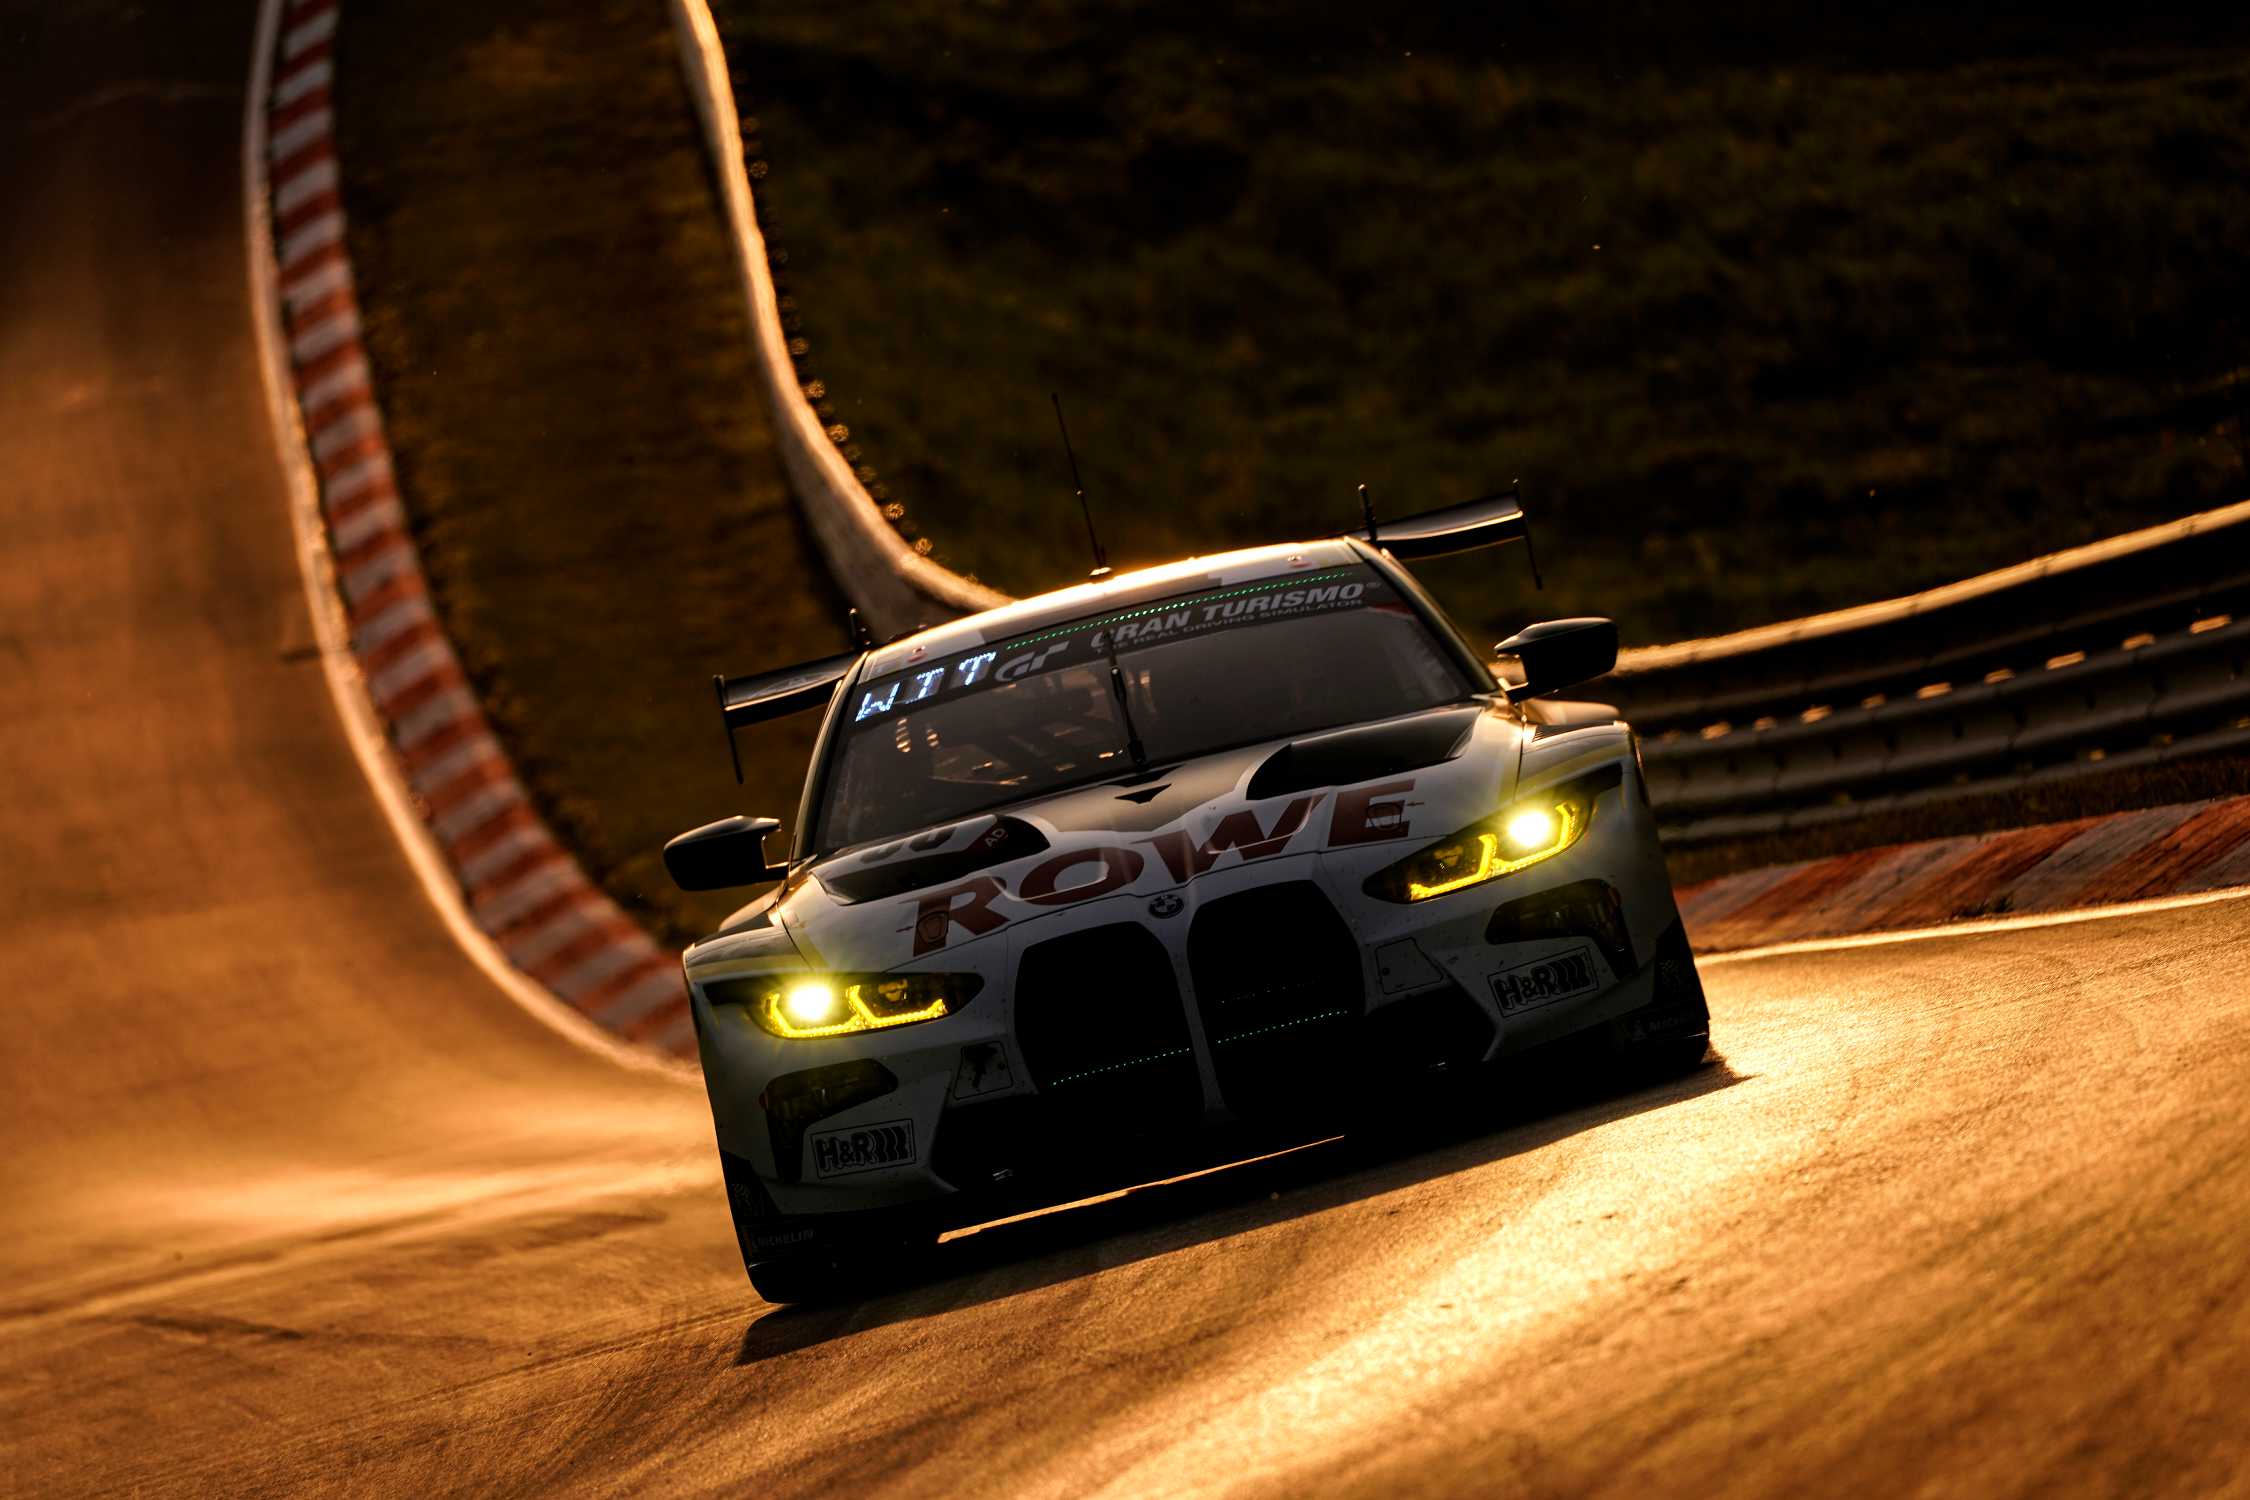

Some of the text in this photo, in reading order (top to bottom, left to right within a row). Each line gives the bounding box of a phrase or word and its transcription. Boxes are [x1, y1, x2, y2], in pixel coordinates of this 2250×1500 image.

[1090, 582, 1366, 648] GRAN TURISMO
[1260, 600, 1363, 617] SIMULATOR
[900, 780, 1416, 957] ROWE
[1494, 964, 1562, 1009] H&R
[815, 1132, 878, 1171] H&R
